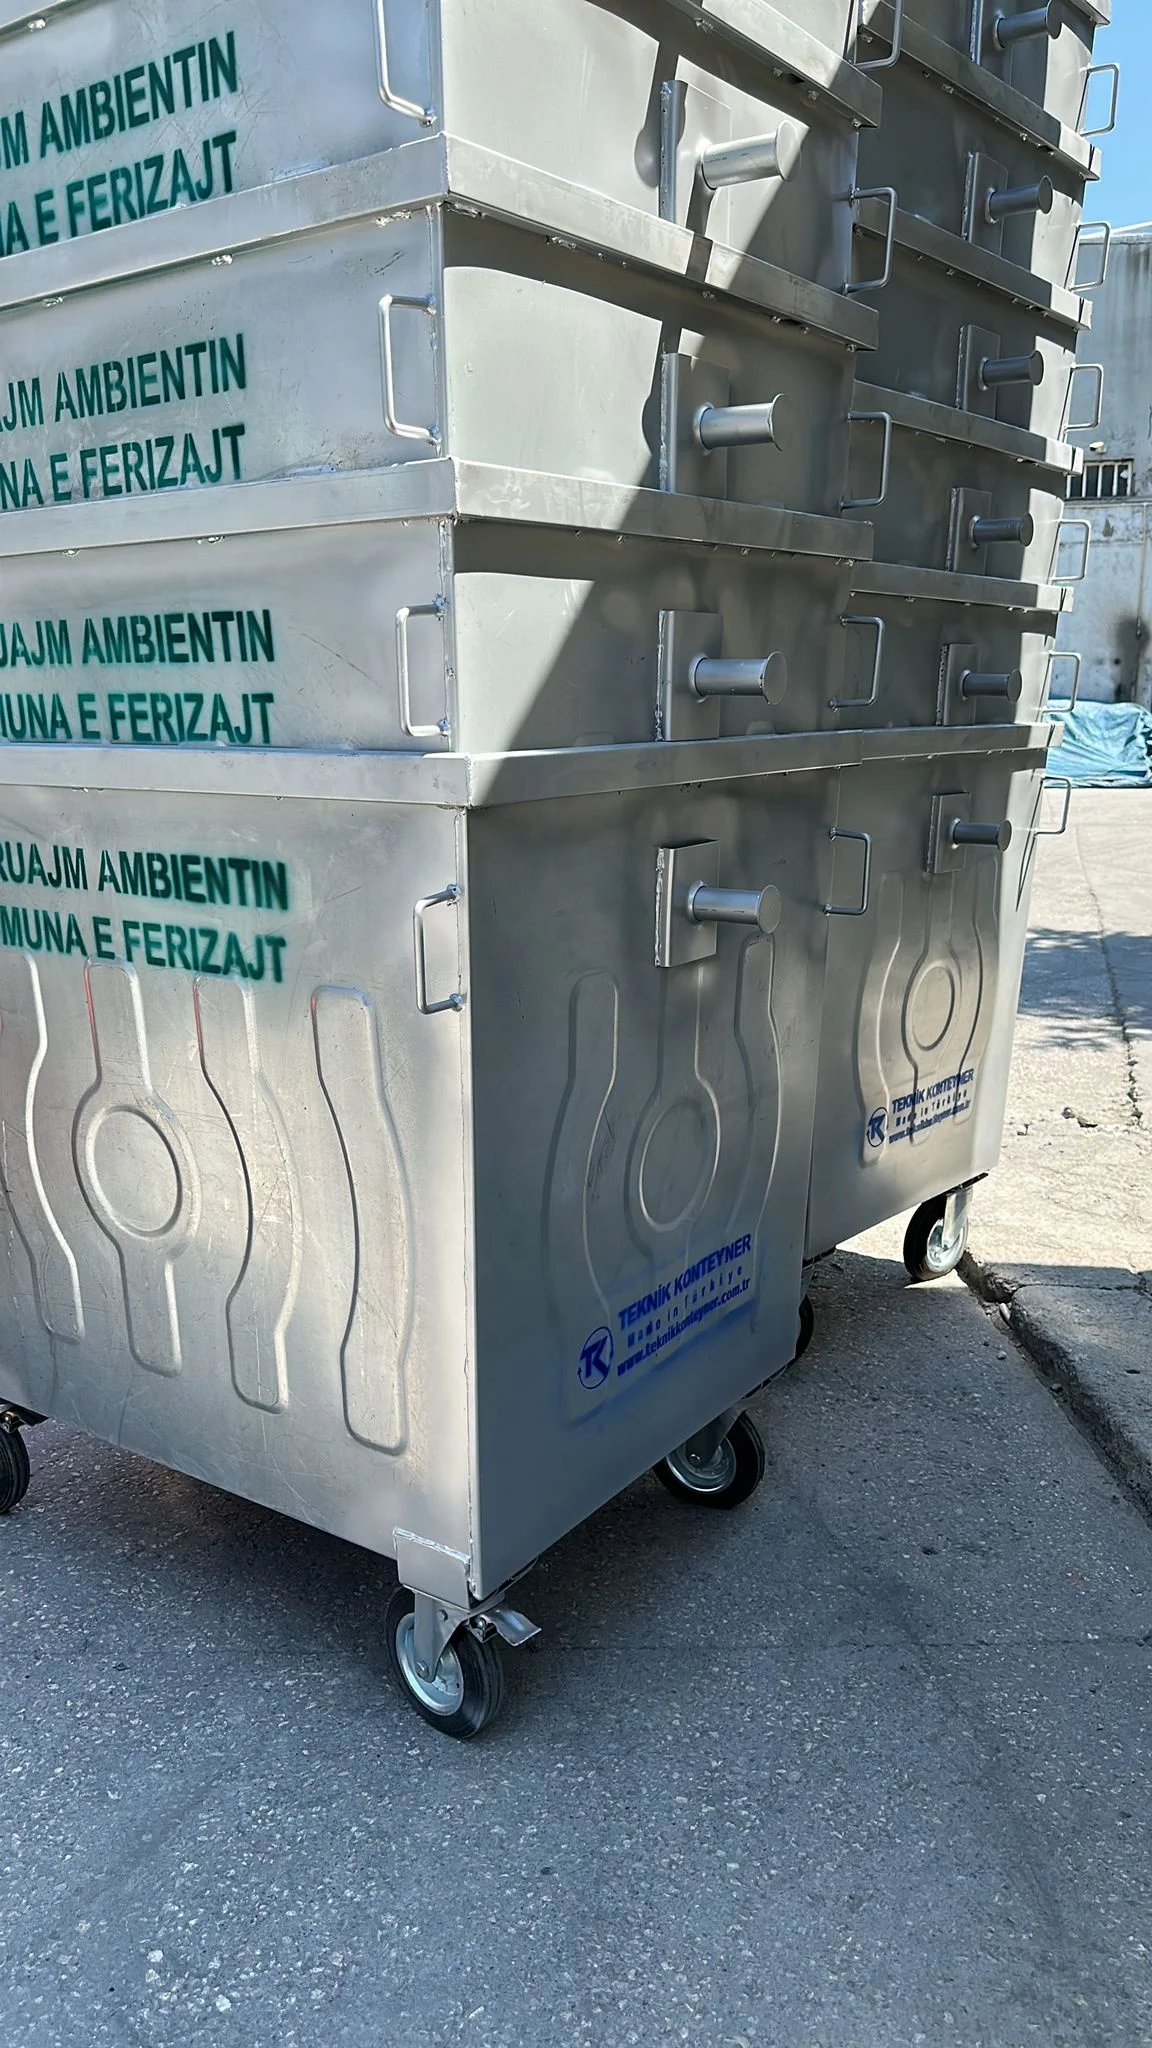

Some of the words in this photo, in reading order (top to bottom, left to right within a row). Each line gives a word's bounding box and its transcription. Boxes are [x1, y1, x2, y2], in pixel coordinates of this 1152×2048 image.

[0, 110, 29, 169] M
[40, 31, 238, 158] AMBIENTIN
[0, 201, 29, 257] A
[35, 189, 59, 246] E
[66, 130, 237, 238] FERIZAJT
[0, 377, 44, 432] JM
[55, 333, 246, 422] AMBIENTIN
[50, 453, 71, 502] E
[80, 423, 245, 499] FERIZAJT
[82, 609, 275, 664] AMBIENTIN
[0, 693, 72, 740] UNA
[77, 692, 101, 740] E
[107, 692, 274, 744] FERIZAJT
[98, 849, 289, 911] AMBIENTIN
[0, 904, 88, 956] MUNA
[92, 916, 115, 960] E
[122, 919, 287, 983] FERIZAJT
[618, 1284, 672, 1331] TEKNİK
[674, 1233, 752, 1297] KONTEYNER
[617, 1277, 751, 1377] www.teknikkonteyner.com.tr
[627, 1319, 661, 1348] Made
[667, 1305, 679, 1322] in
